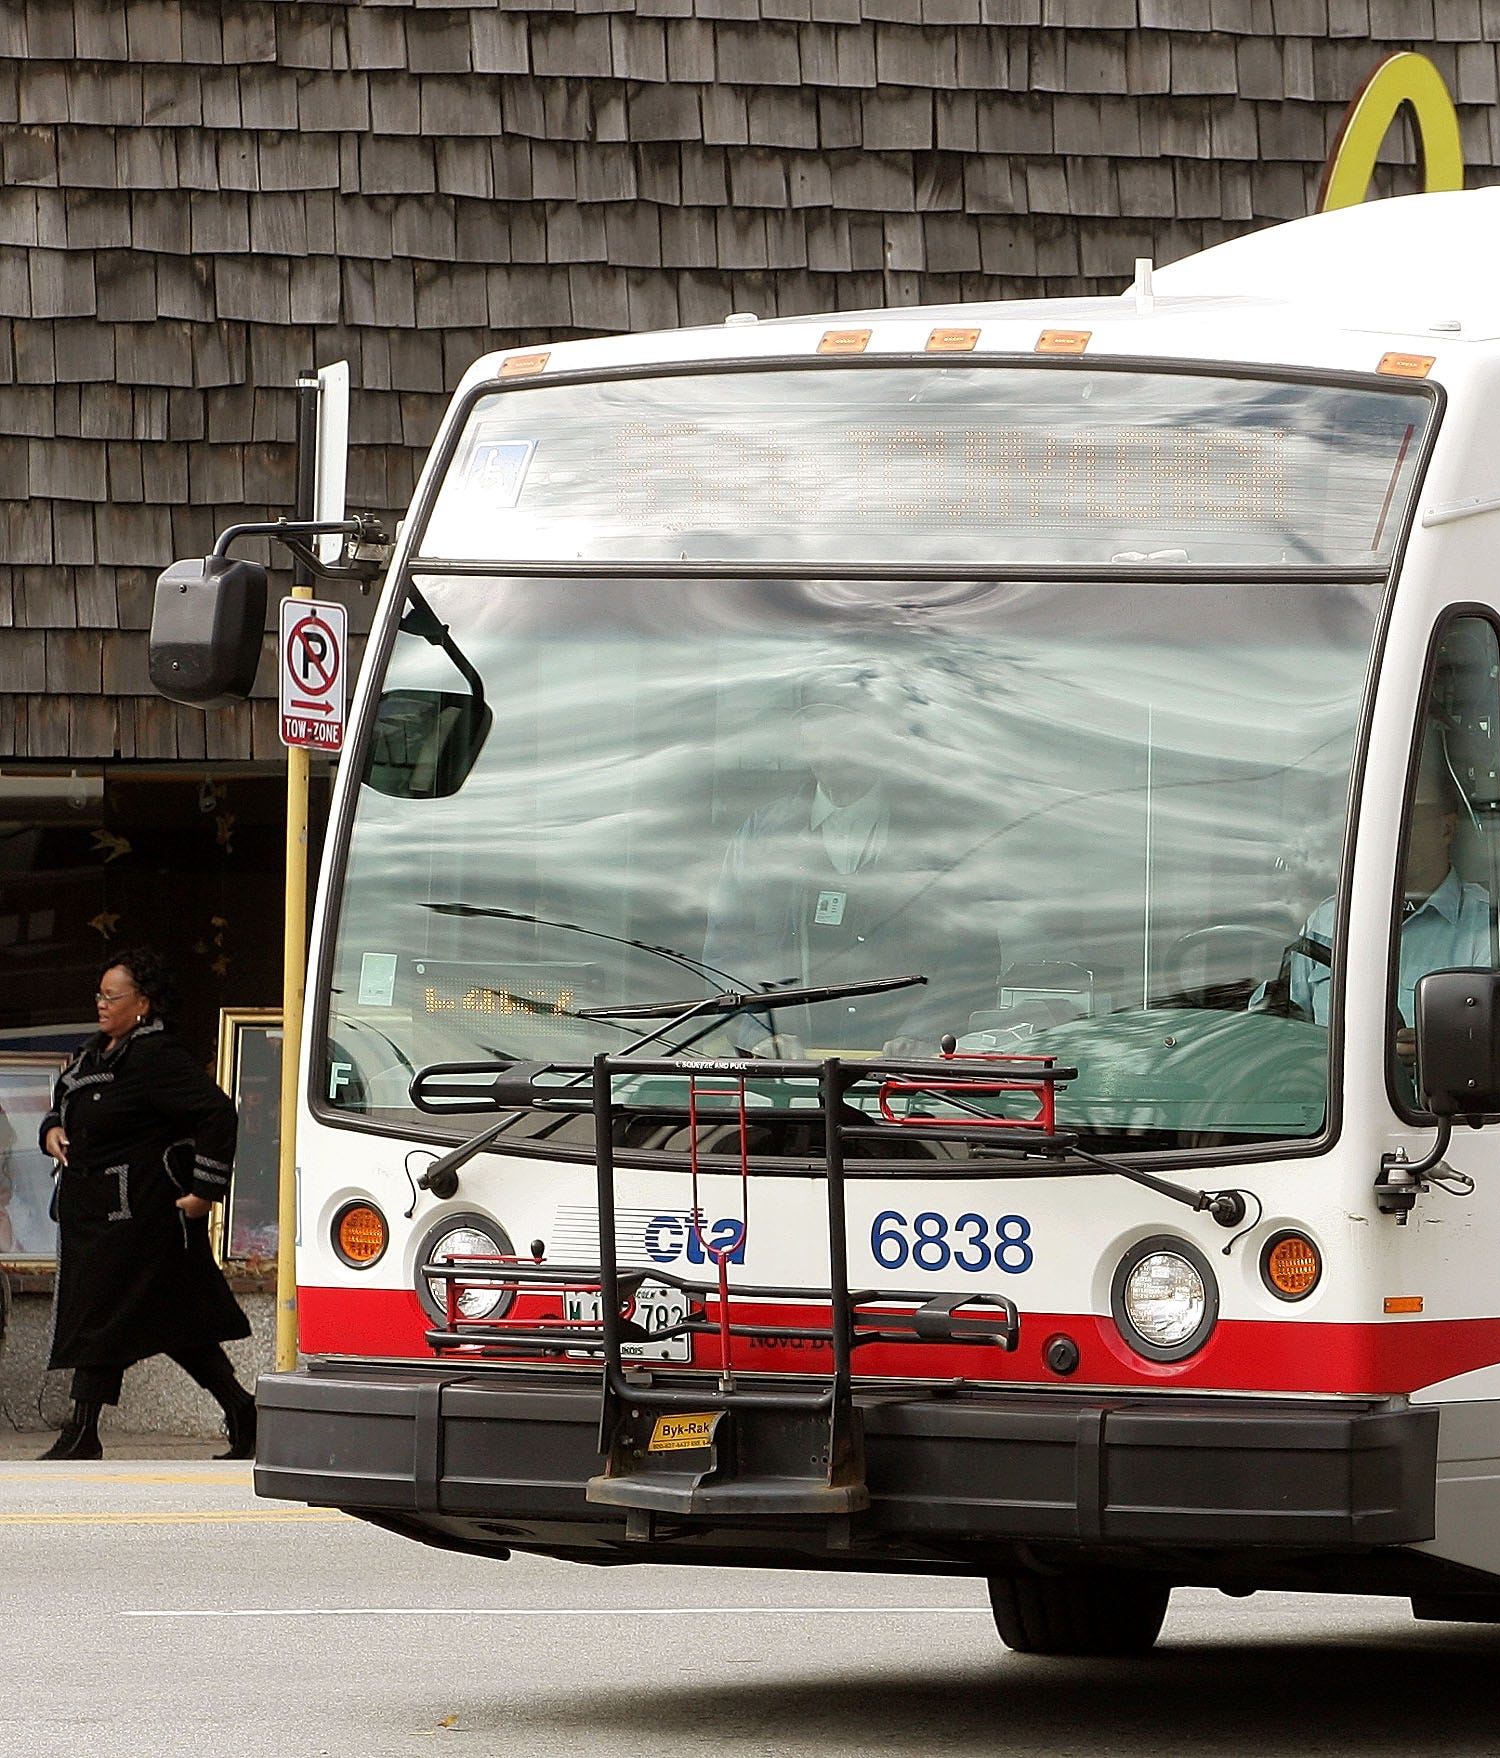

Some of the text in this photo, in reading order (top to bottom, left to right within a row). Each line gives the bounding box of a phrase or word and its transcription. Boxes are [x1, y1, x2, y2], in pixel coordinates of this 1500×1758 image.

[285, 718, 339, 743] TOW-ZONE
[329, 1062, 351, 1099] F
[714, 1062, 728, 1070] AND
[645, 1207, 746, 1264] cta
[871, 1210, 1033, 1274] 6838
[662, 1422, 710, 1438] Byk-Rak
